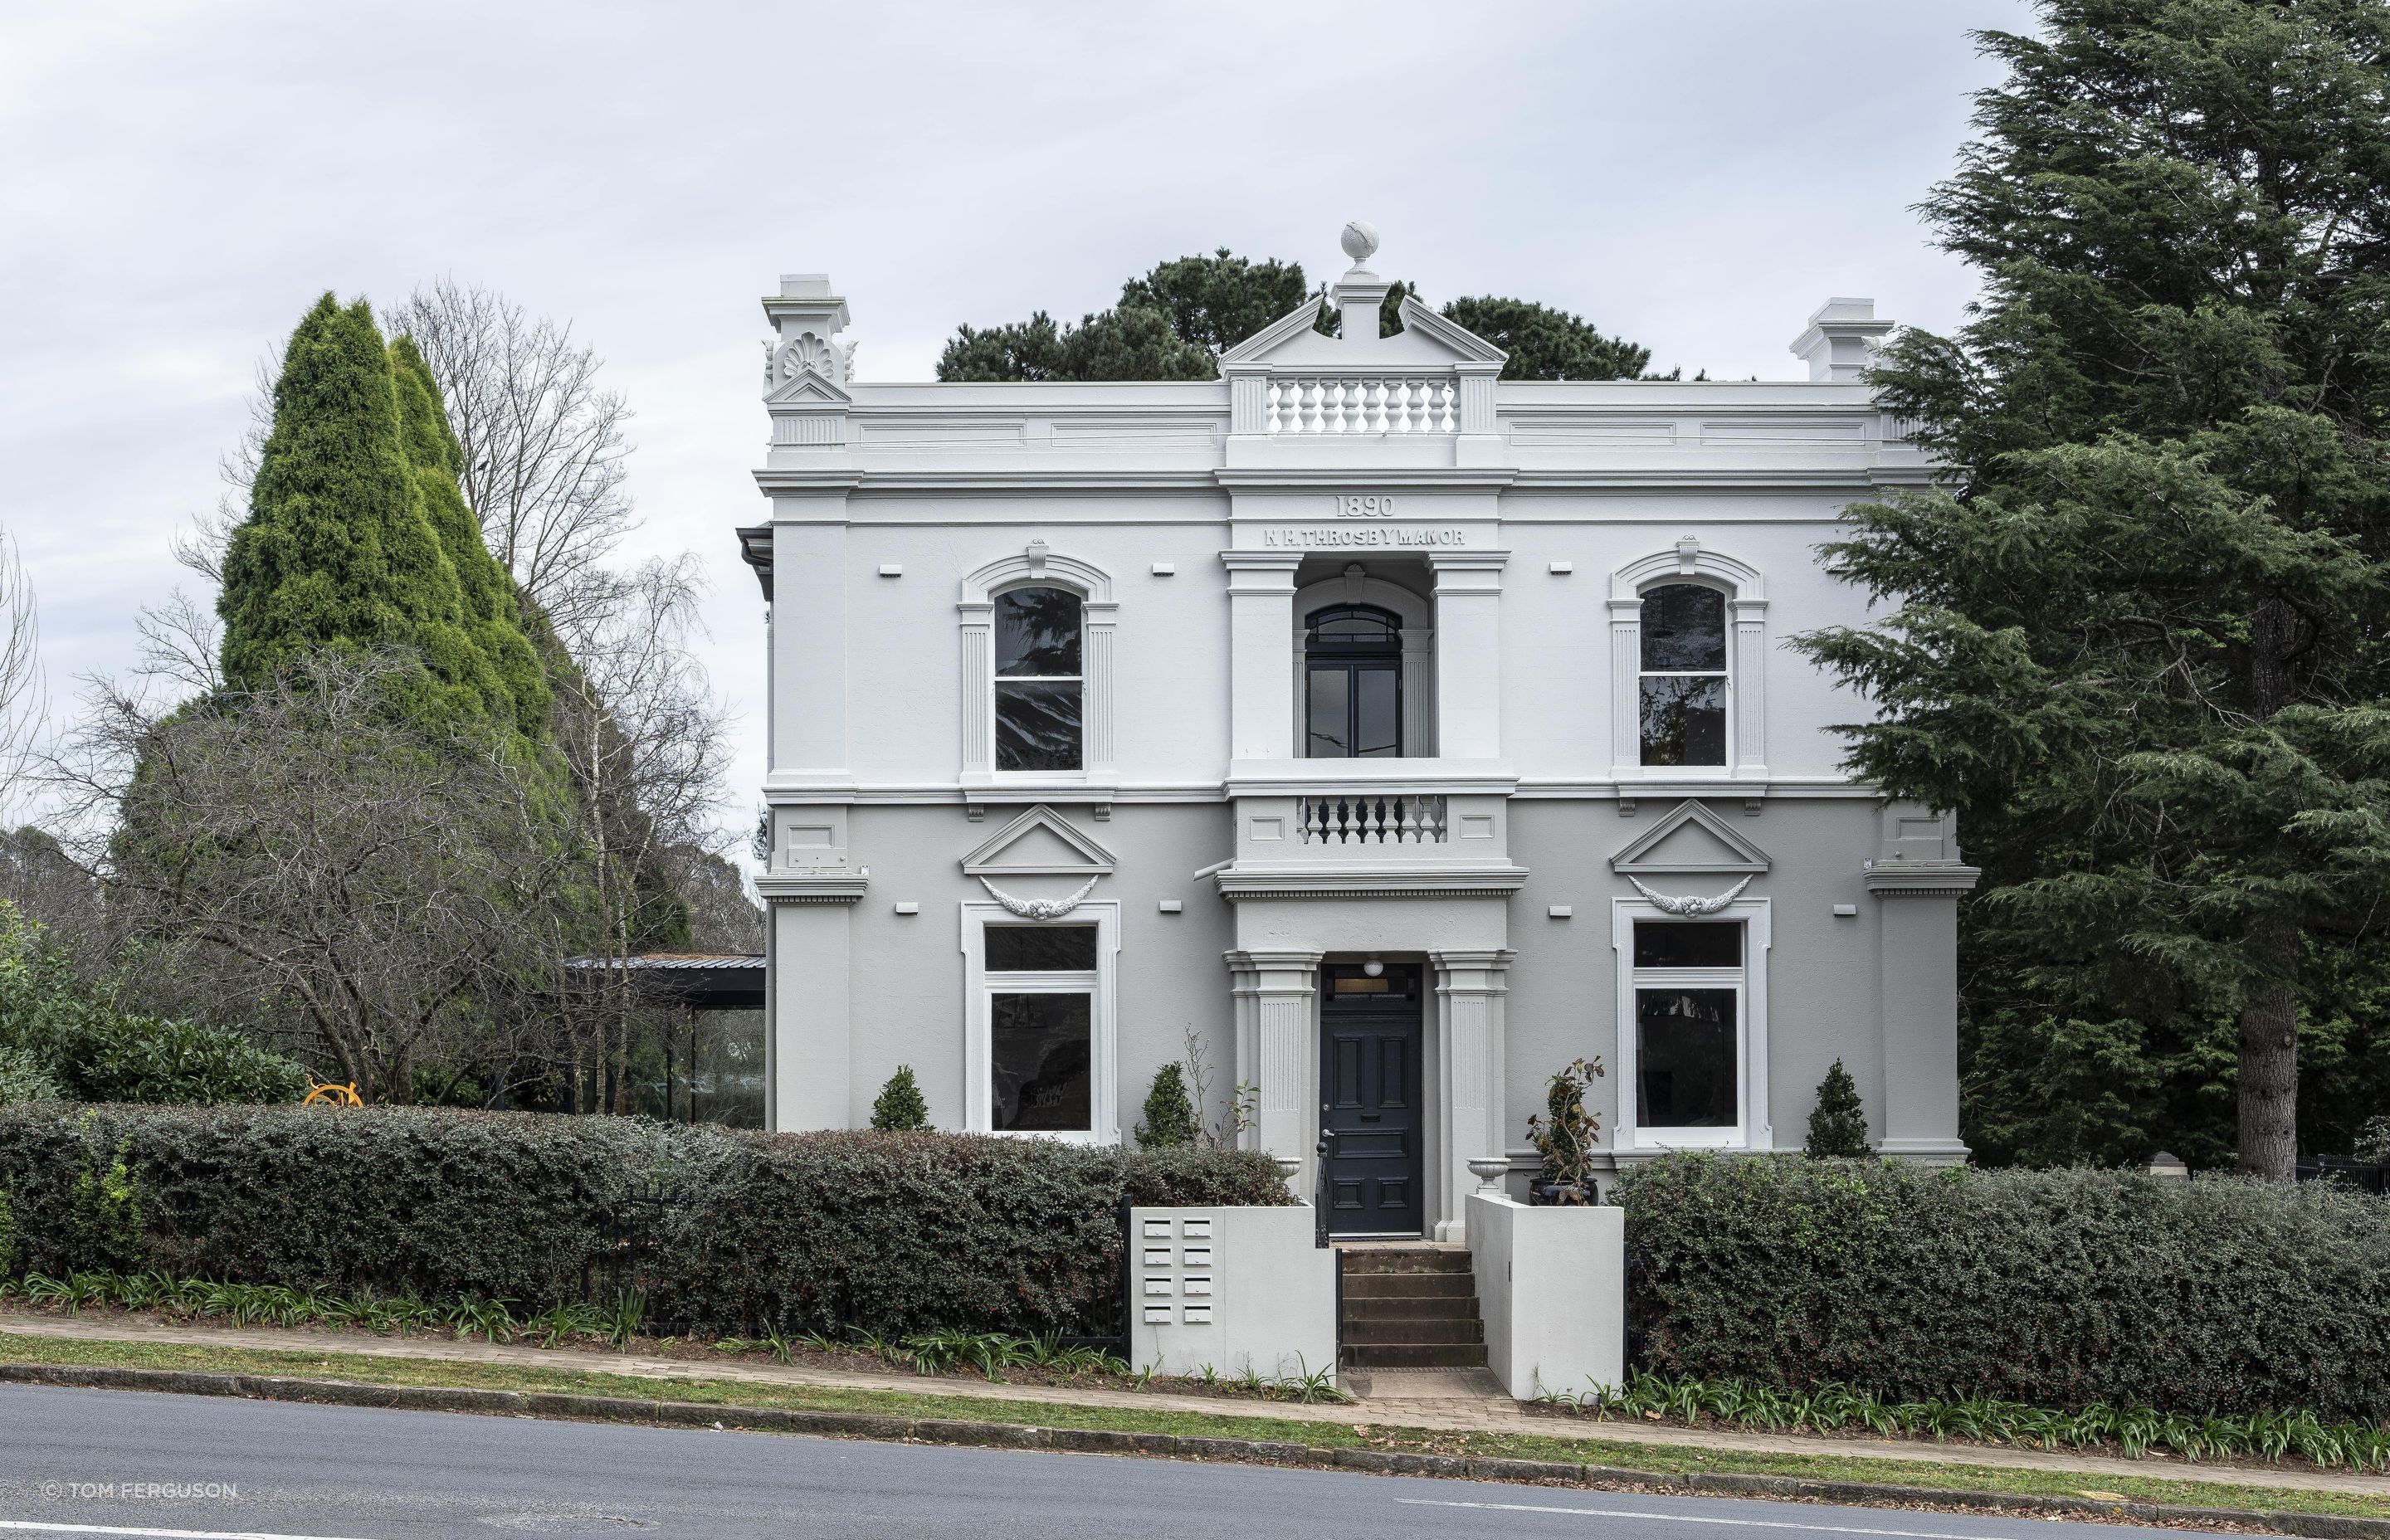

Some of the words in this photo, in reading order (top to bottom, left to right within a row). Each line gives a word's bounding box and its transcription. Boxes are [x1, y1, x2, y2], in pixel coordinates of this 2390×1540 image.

[1335, 495, 1395, 517] 1890
[1301, 528, 1394, 546] THROSBY
[1397, 529, 1466, 545] MANOR
